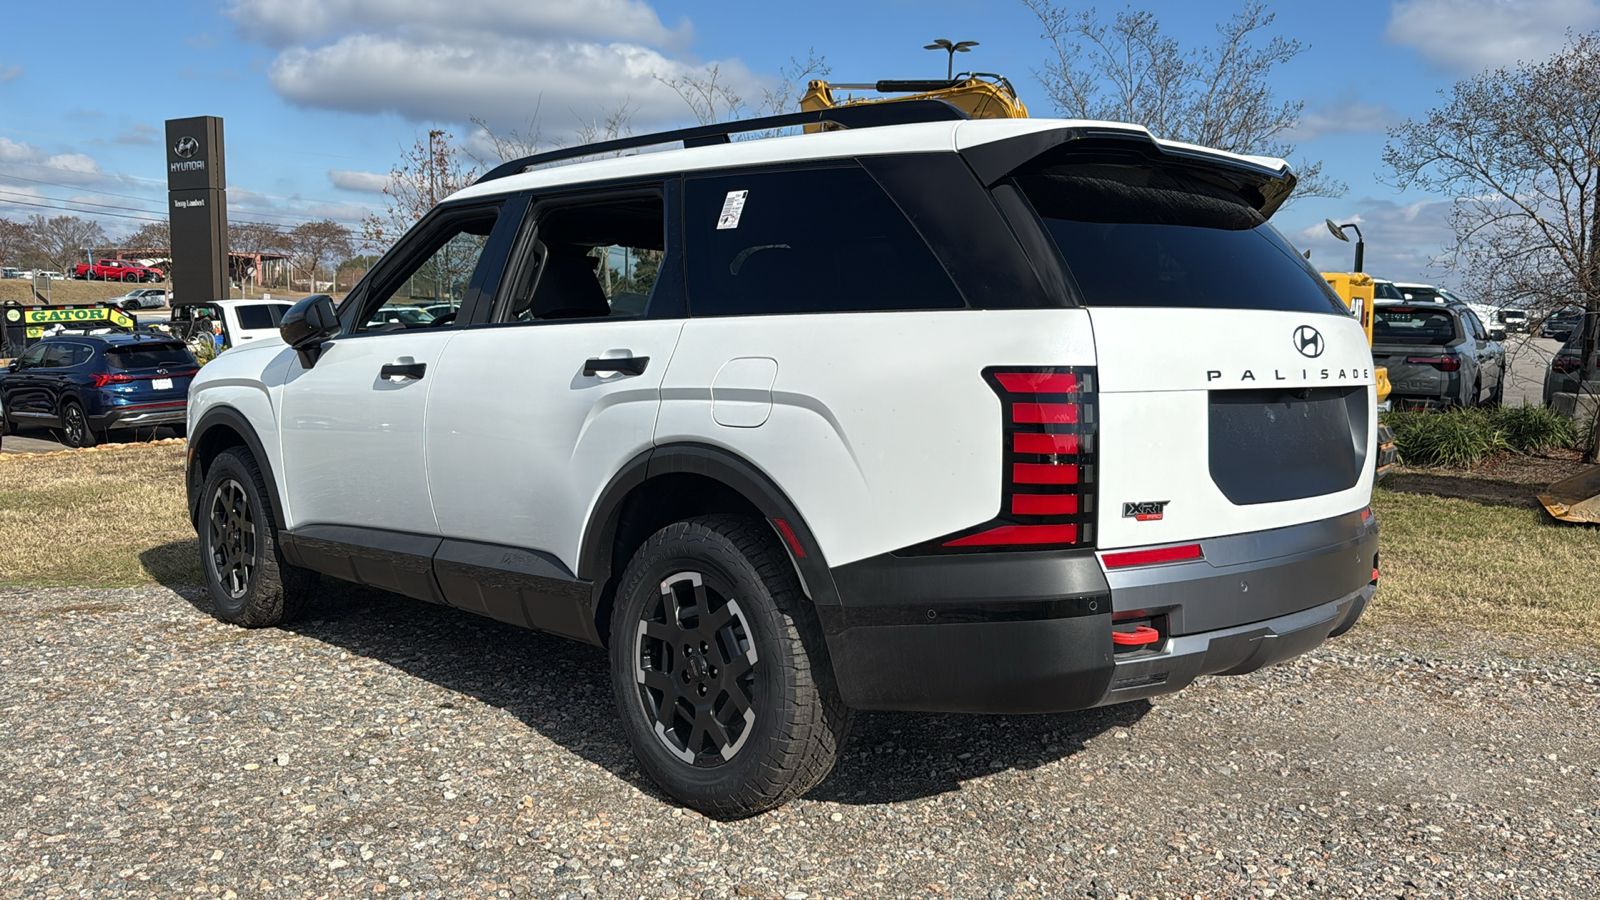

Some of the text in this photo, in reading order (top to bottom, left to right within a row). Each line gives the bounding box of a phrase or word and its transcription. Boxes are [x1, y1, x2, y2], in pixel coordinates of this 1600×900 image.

[170, 160, 205, 173] HYUNDAI
[31, 309, 104, 322] GATOR
[1207, 368, 1369, 382] PALISADE
[1123, 500, 1171, 517] XRT
